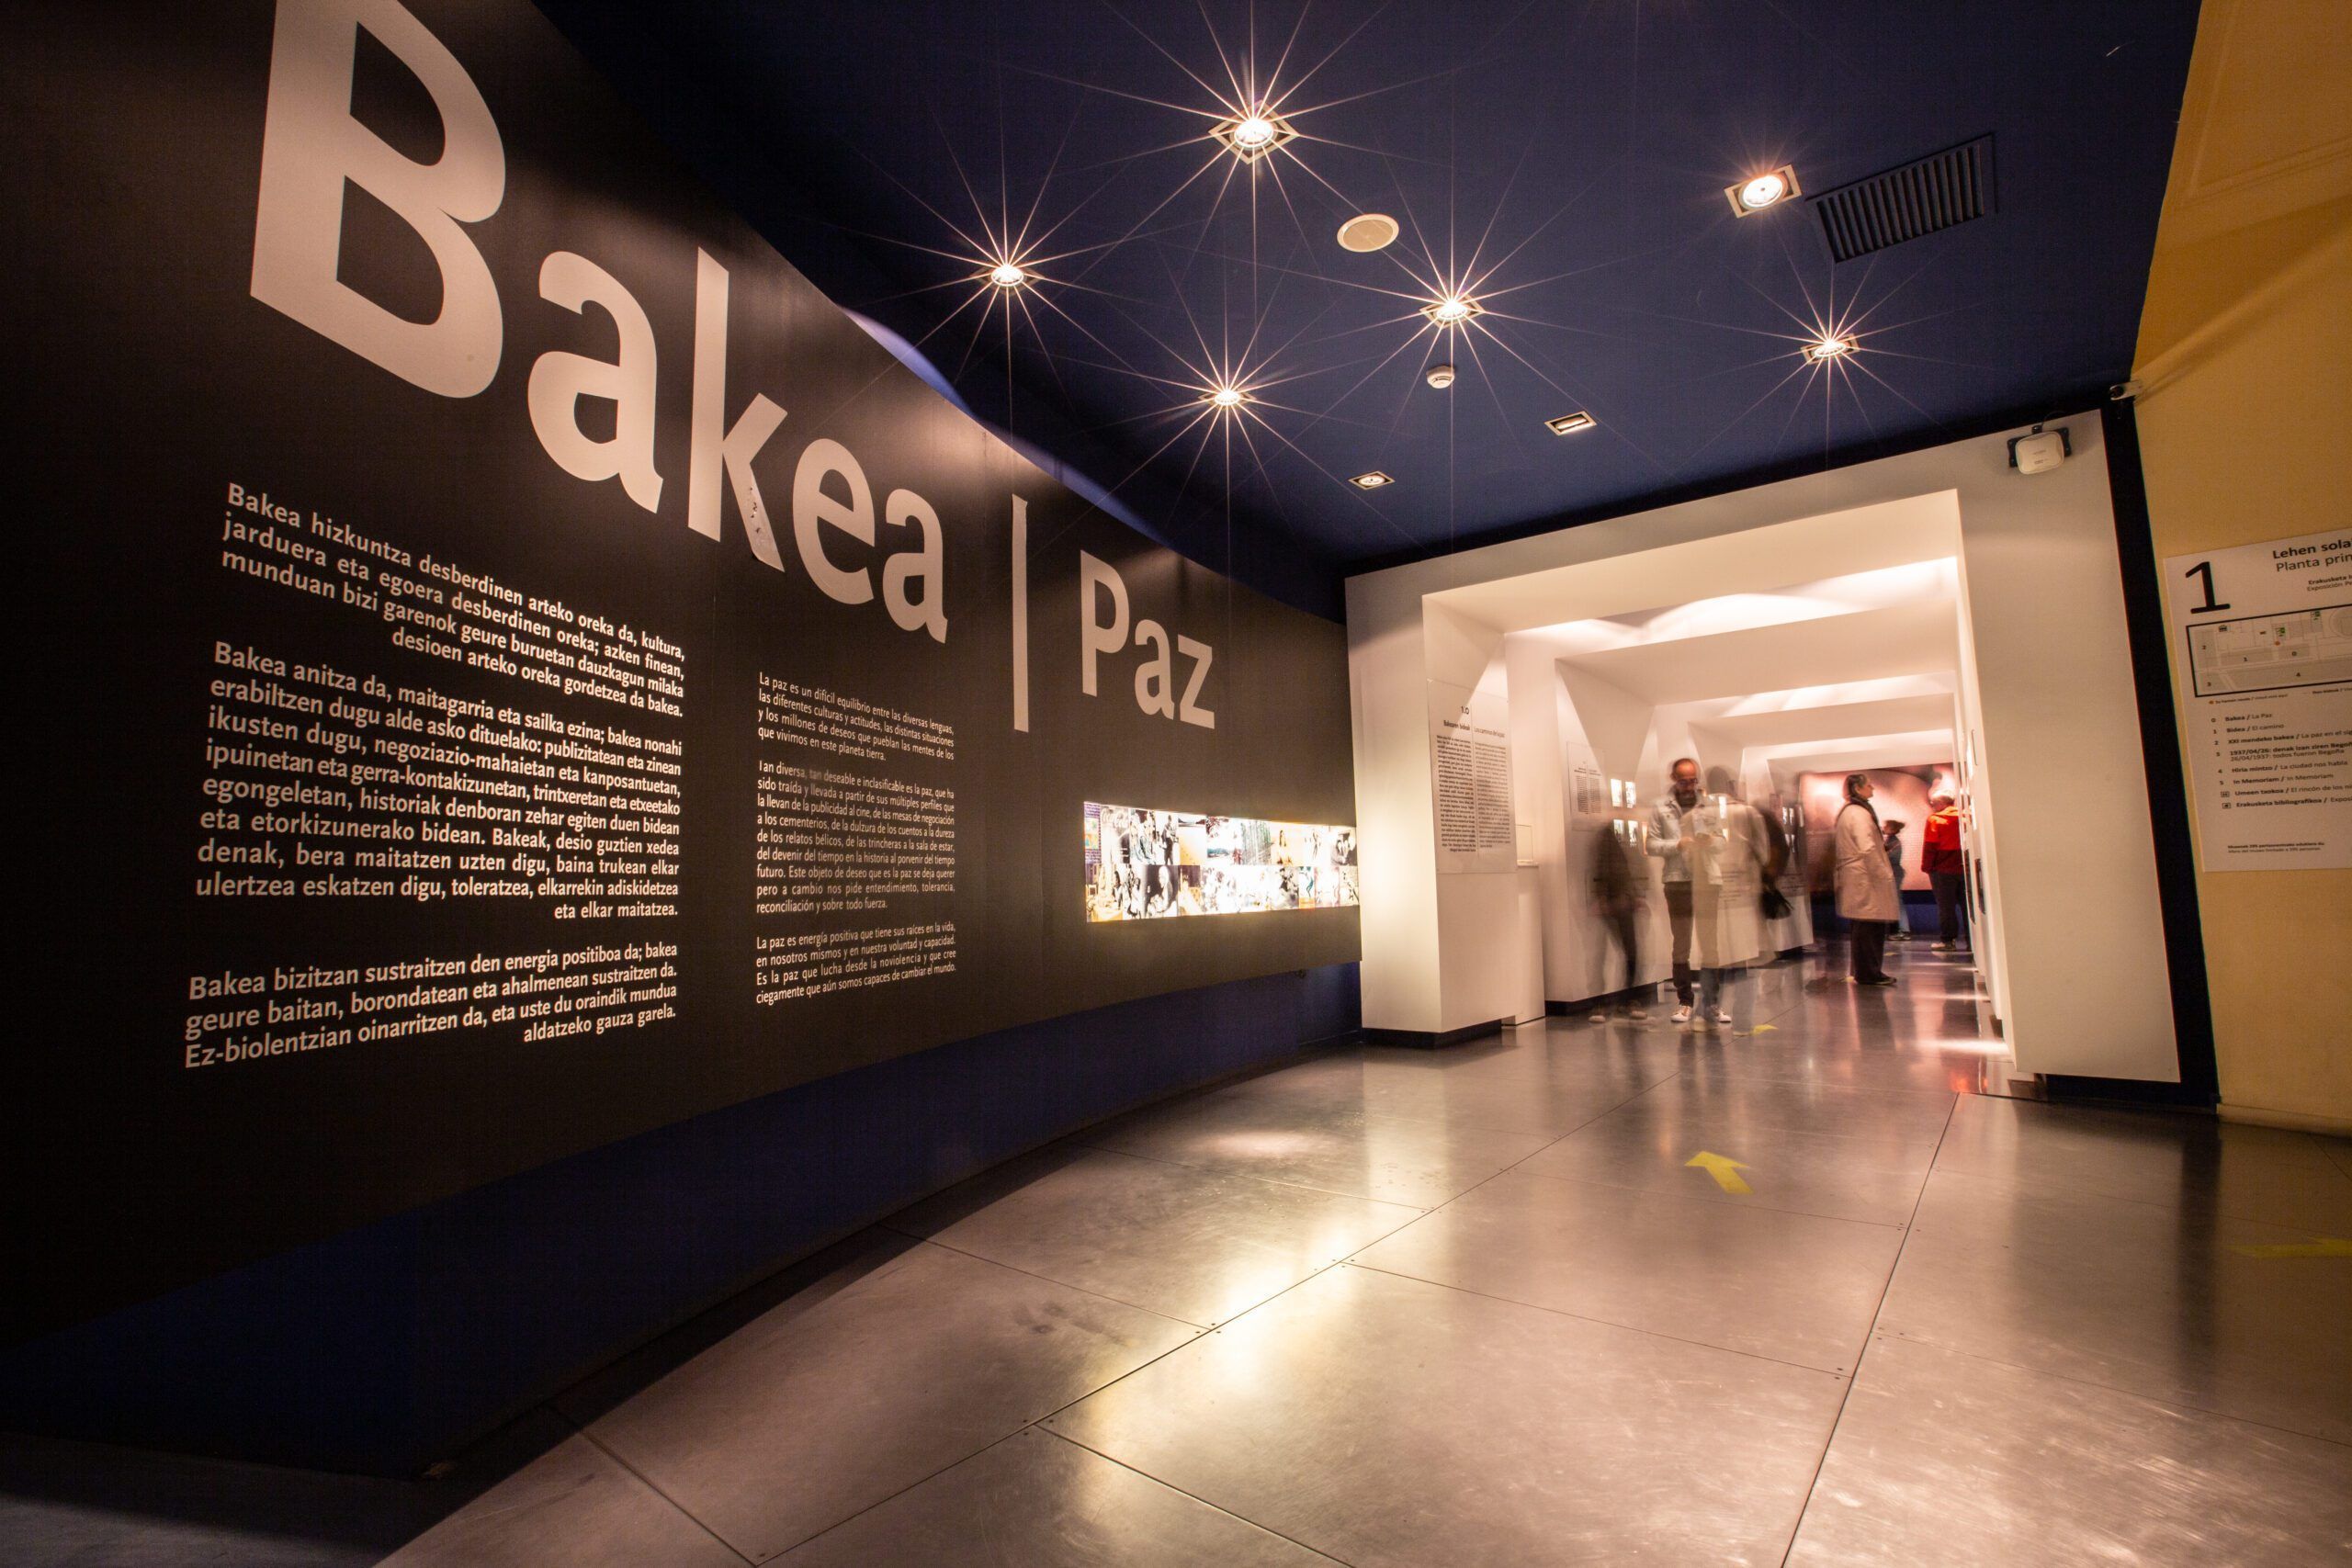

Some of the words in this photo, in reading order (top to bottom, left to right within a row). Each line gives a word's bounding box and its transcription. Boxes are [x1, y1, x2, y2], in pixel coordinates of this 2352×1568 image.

[250, 0, 947, 643] Bakea
[1080, 549, 1215, 729] Paz
[228, 483, 300, 527] Bakea
[311, 513, 411, 567] hizkuntza
[419, 555, 522, 605] desberdinen
[528, 598, 573, 622] arteko
[578, 615, 614, 637] oreka
[618, 625, 637, 647] da,
[641, 631, 684, 661] kultura,
[2186, 561, 2231, 614] 1
[2273, 547, 2316, 559] Lehen
[2321, 539, 2352, 552] sola
[2276, 559, 2320, 571] Planta
[222, 513, 325, 566] jarduera
[337, 558, 368, 580] eta
[379, 573, 442, 604] egoera
[452, 592, 550, 637] desberdinen
[557, 630, 598, 656] oreka;
[605, 644, 639, 665] azken
[645, 653, 684, 681] finean,
[222, 551, 334, 598] munduan
[344, 581, 378, 611] bizi
[383, 602, 456, 634] garenok
[461, 626, 506, 649] geure
[511, 634, 573, 668] buruetan
[578, 655, 644, 687] dauzkagun
[648, 677, 683, 697] milaka
[215, 641, 285, 676] Bakea
[293, 664, 356, 691] anitza
[363, 675, 391, 703] da,
[399, 688, 493, 719] maitagarria
[498, 708, 520, 725] eta
[525, 713, 563, 733] sailka
[567, 721, 604, 744] ezina;
[608, 727, 641, 748] bakea
[645, 739, 682, 756] nonahi
[392, 626, 461, 661] desioen
[468, 652, 516, 675] arteko
[521, 667, 560, 687] oreka
[564, 678, 626, 704] gordetzea
[630, 691, 644, 707] da
[648, 694, 683, 716] bakea.
[759, 671, 769, 685] La
[772, 679, 787, 691] paz
[789, 683, 798, 694] es
[801, 687, 811, 697] un
[814, 687, 834, 704] difícil
[836, 697, 870, 713] equilibrio
[872, 706, 889, 718] entre
[891, 708, 900, 721] las
[902, 712, 928, 728] diversas
[209, 705, 298, 740] ikusten
[307, 722, 366, 755] dugu,
[375, 739, 554, 778] negoziazio-mahaietan
[559, 766, 579, 782] eta
[583, 766, 680, 798] kanposantuetan,
[210, 679, 322, 714] erabiltzen
[329, 696, 379, 728] dugu
[386, 708, 423, 731] alde
[427, 717, 465, 739] asko
[469, 724, 541, 752] dituelako:
[545, 739, 624, 766] publizitatean
[627, 755, 644, 770] eta
[647, 757, 681, 775] zinean
[757, 727, 775, 740] que
[775, 728, 808, 745] vivimos
[809, 738, 819, 747] en
[820, 740, 836, 750] este
[838, 740, 865, 756] planeta
[759, 688, 771, 703] las
[773, 693, 811, 714] diferentes
[813, 705, 842, 721] culturas
[844, 715, 848, 725] y
[884, 720, 893, 733] las
[894, 724, 921, 739] distintas
[922, 731, 954, 747] situaciones
[203, 779, 352, 811] egongeletan,
[360, 787, 440, 815] historiak
[446, 797, 521, 822] denboran
[526, 807, 564, 825] zehar
[567, 811, 606, 831] egiten
[610, 814, 639, 831] duen
[643, 817, 679, 835] bidean
[207, 738, 312, 773] ipuinetan
[318, 759, 347, 777] eta
[351, 765, 530, 802] gerra-kontakizunetan,
[533, 784, 606, 807] trintxeretan
[609, 795, 627, 809] eta
[629, 797, 680, 815] etxeetako
[189, 971, 265, 999] Bakea
[274, 966, 357, 990] bizitzan
[365, 958, 465, 982] sustraitzen
[470, 953, 500, 973] den
[504, 949, 558, 973] energia
[562, 946, 620, 970] positiboa
[624, 944, 642, 962] da;
[646, 942, 677, 958] bakea
[755, 956, 767, 967] en
[770, 952, 808, 965] nosotros
[809, 948, 841, 960] mismos
[843, 948, 847, 960] y
[849, 947, 858, 955] en
[861, 943, 887, 954] nuestra
[888, 937, 917, 951] voluntad
[918, 941, 922, 951] y
[185, 1010, 259, 1041] geure
[268, 998, 343, 1023] baitan,
[351, 986, 468, 1013] borondatean
[472, 982, 496, 998] eta
[502, 975, 587, 996] ahalmenean
[592, 965, 657, 985] sustraitzen
[661, 962, 676, 977] da.
[186, 1026, 351, 1068] Ez-biolentzian
[357, 1013, 457, 1042] oinarritzen
[462, 1007, 487, 1027] da,
[492, 1005, 514, 1021] eta
[520, 1000, 550, 1018] uste
[554, 995, 571, 1013] du
[576, 987, 627, 1010] oraindik
[630, 983, 676, 1002] mundua
[524, 1016, 592, 1042] aldatzeko
[596, 1013, 633, 1034] gauza
[638, 1003, 675, 1027] garela.
